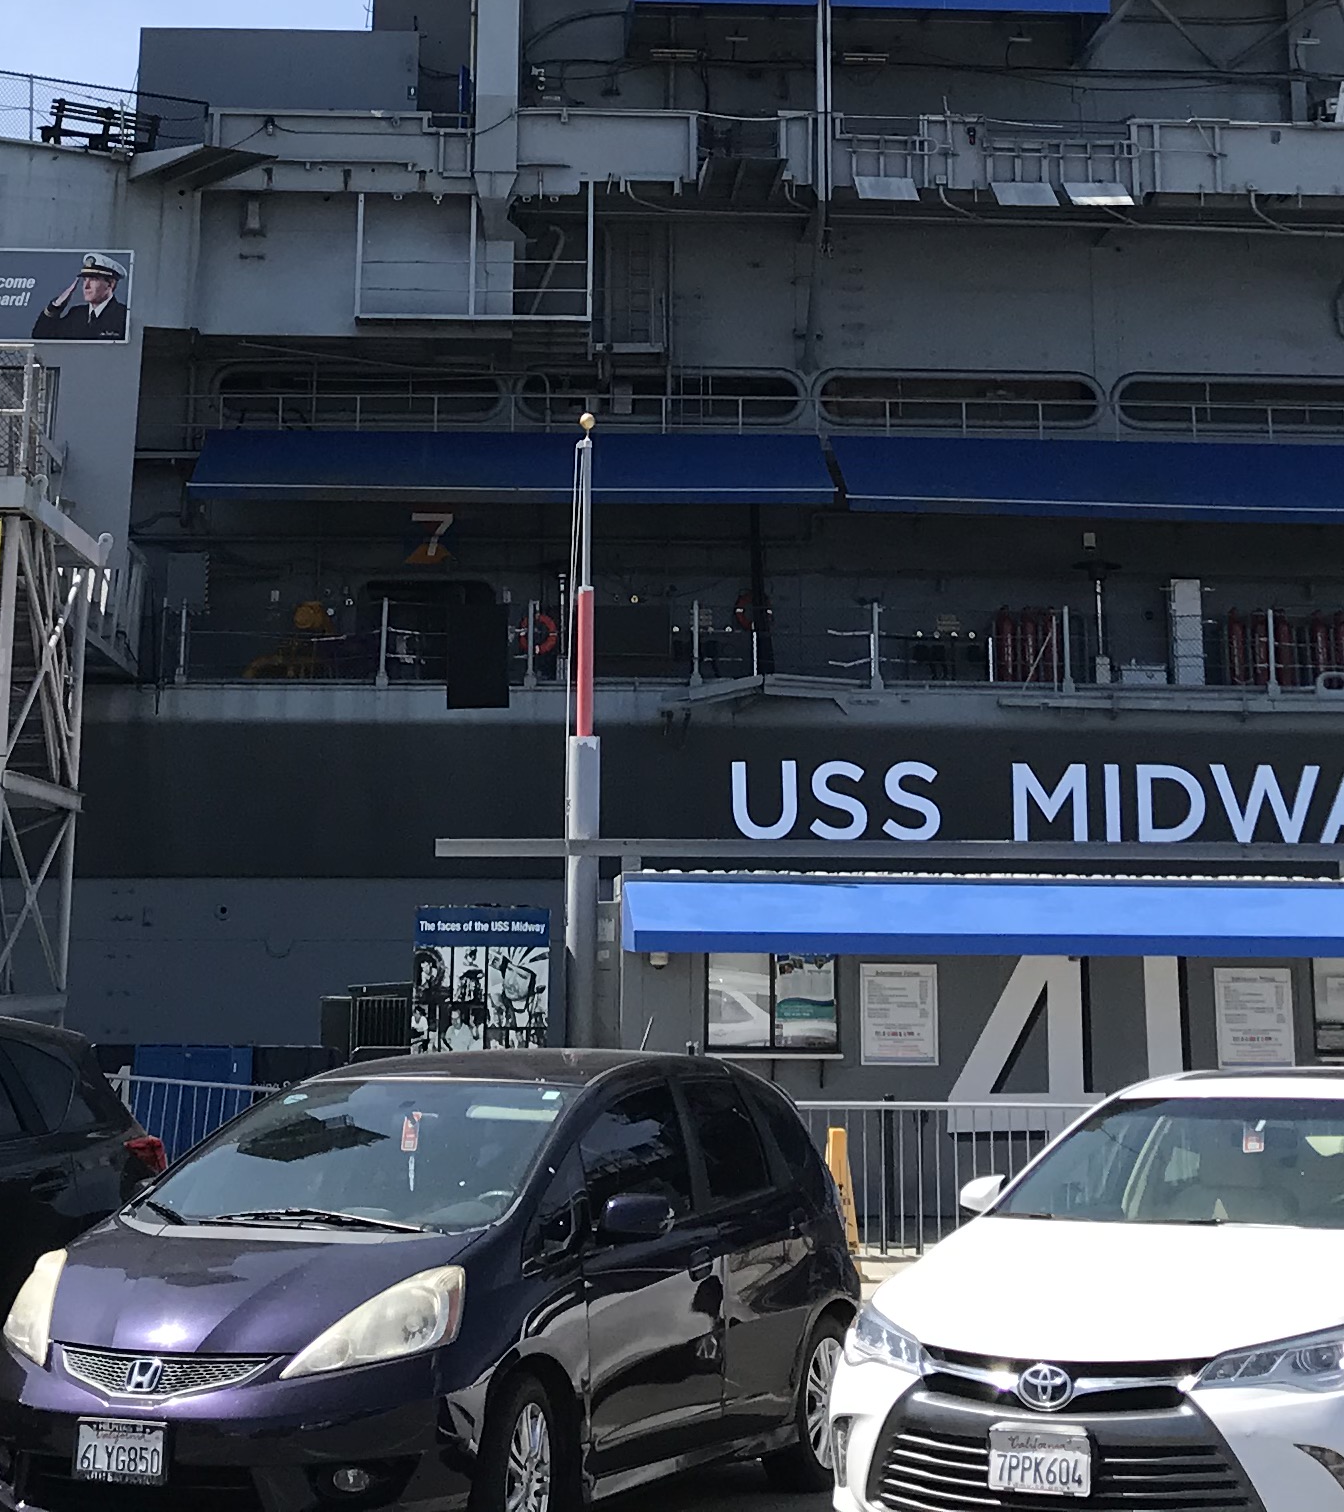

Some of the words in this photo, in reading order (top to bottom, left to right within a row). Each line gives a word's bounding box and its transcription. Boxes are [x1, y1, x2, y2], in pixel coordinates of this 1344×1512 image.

[411, 512, 454, 557] 7
[728, 759, 942, 841] USS
[419, 920, 435, 932] The
[437, 920, 461, 932] faces
[462, 920, 473, 932] of
[474, 920, 490, 932] the
[491, 920, 509, 932] USS
[511, 921, 546, 934] Midway
[947, 955, 1192, 1143] 41
[80, 1443, 160, 1475] 6LYG850
[1008, 1434, 1069, 1452] California
[997, 1453, 1082, 1487] 7PPK604
